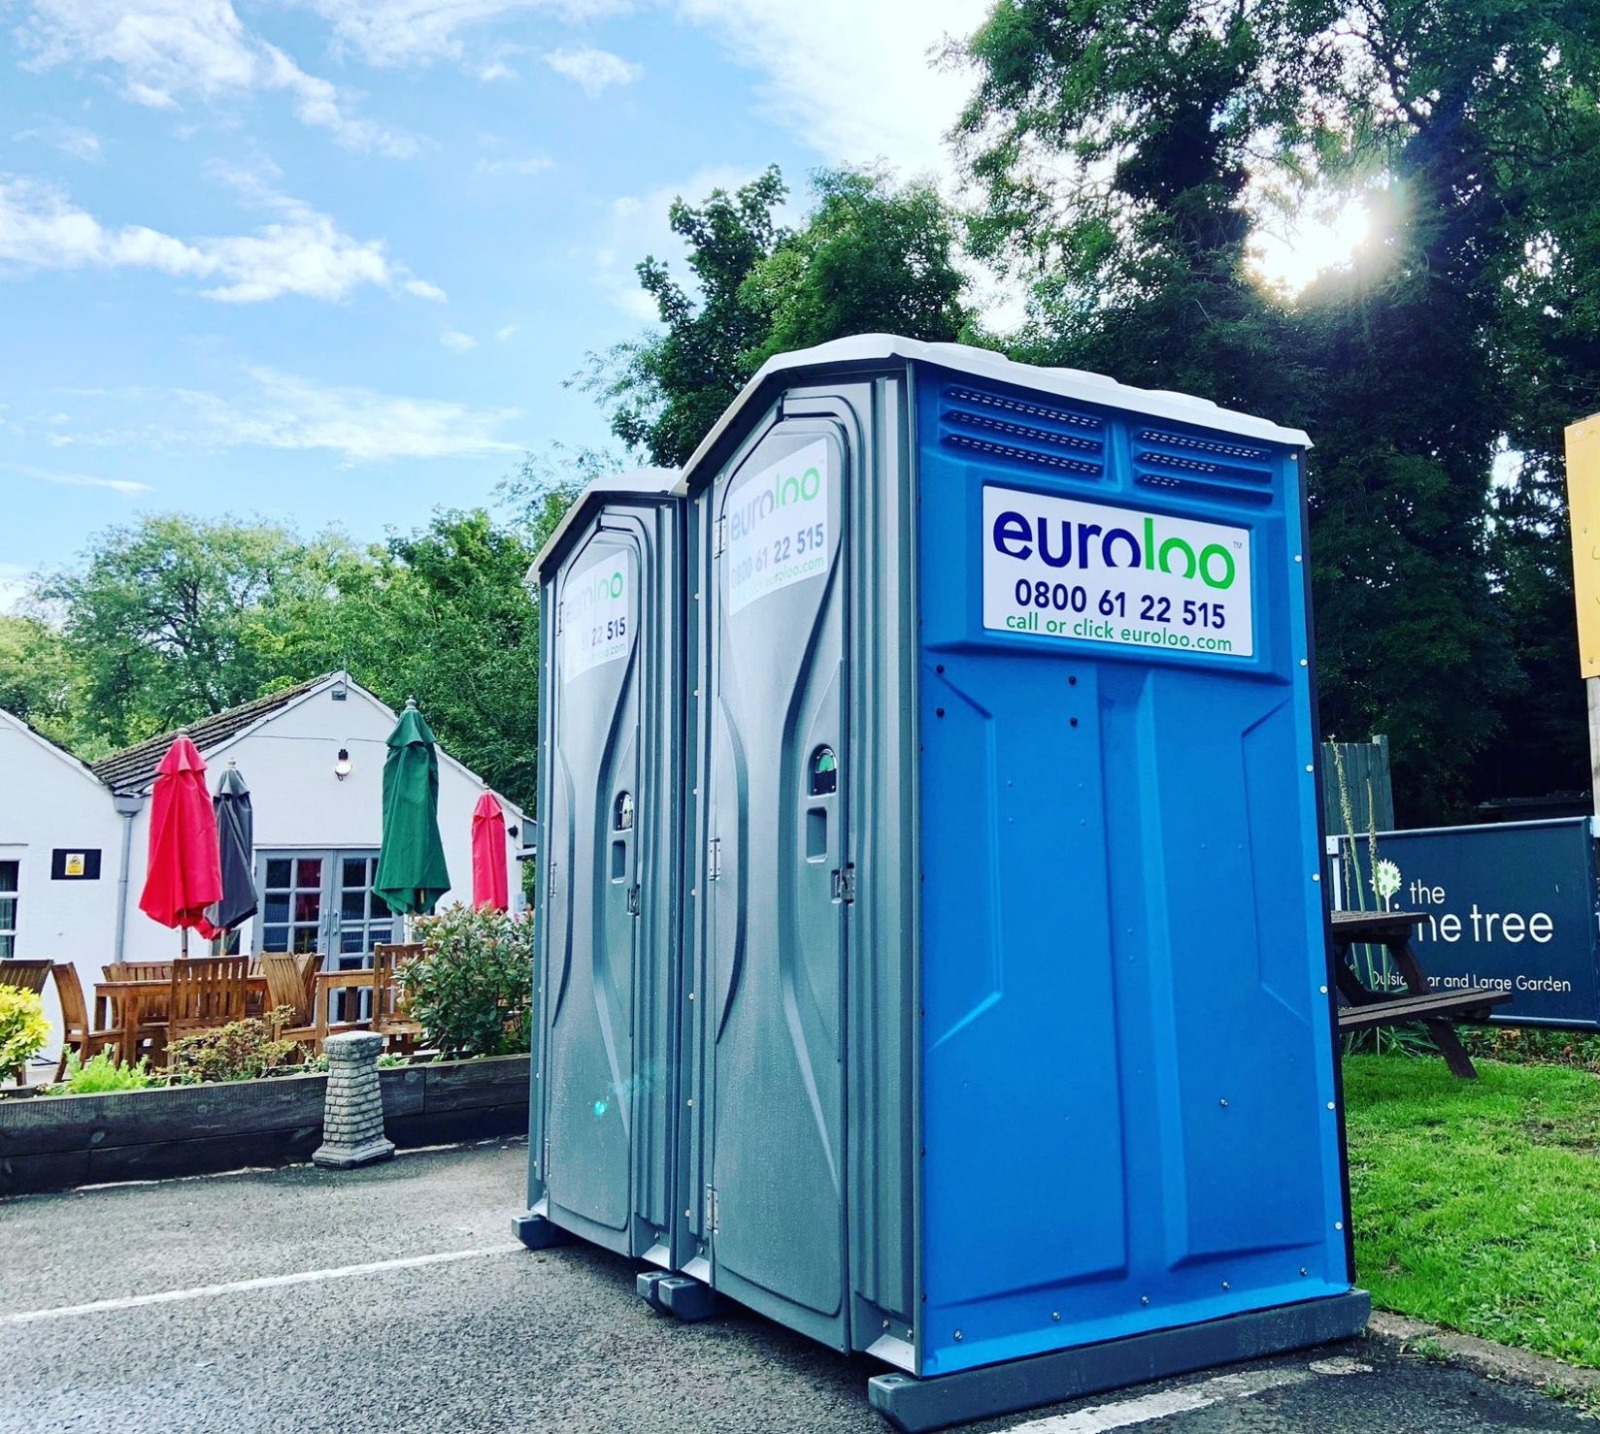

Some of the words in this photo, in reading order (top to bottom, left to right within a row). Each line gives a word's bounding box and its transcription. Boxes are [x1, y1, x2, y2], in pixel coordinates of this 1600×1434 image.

[731, 466, 821, 541] euroloo
[756, 546, 768, 572] 61
[773, 536, 791, 564] 22
[796, 523, 824, 554] 515
[993, 511, 1235, 590] euroloo
[1015, 578, 1087, 613] 0800
[1098, 589, 1126, 618] 61
[1140, 594, 1171, 623] 22
[1182, 600, 1226, 629] 515
[607, 616, 626, 640] 515
[1006, 611, 1038, 631] call
[1046, 620, 1067, 634] or
[1073, 618, 1114, 639] click
[1121, 627, 1232, 652] euroloo.com
[1409, 879, 1445, 904] the
[1470, 904, 1554, 943] tree
[1444, 973, 1469, 988] and
[1473, 974, 1512, 991] Large
[1516, 975, 1571, 992] Garden
